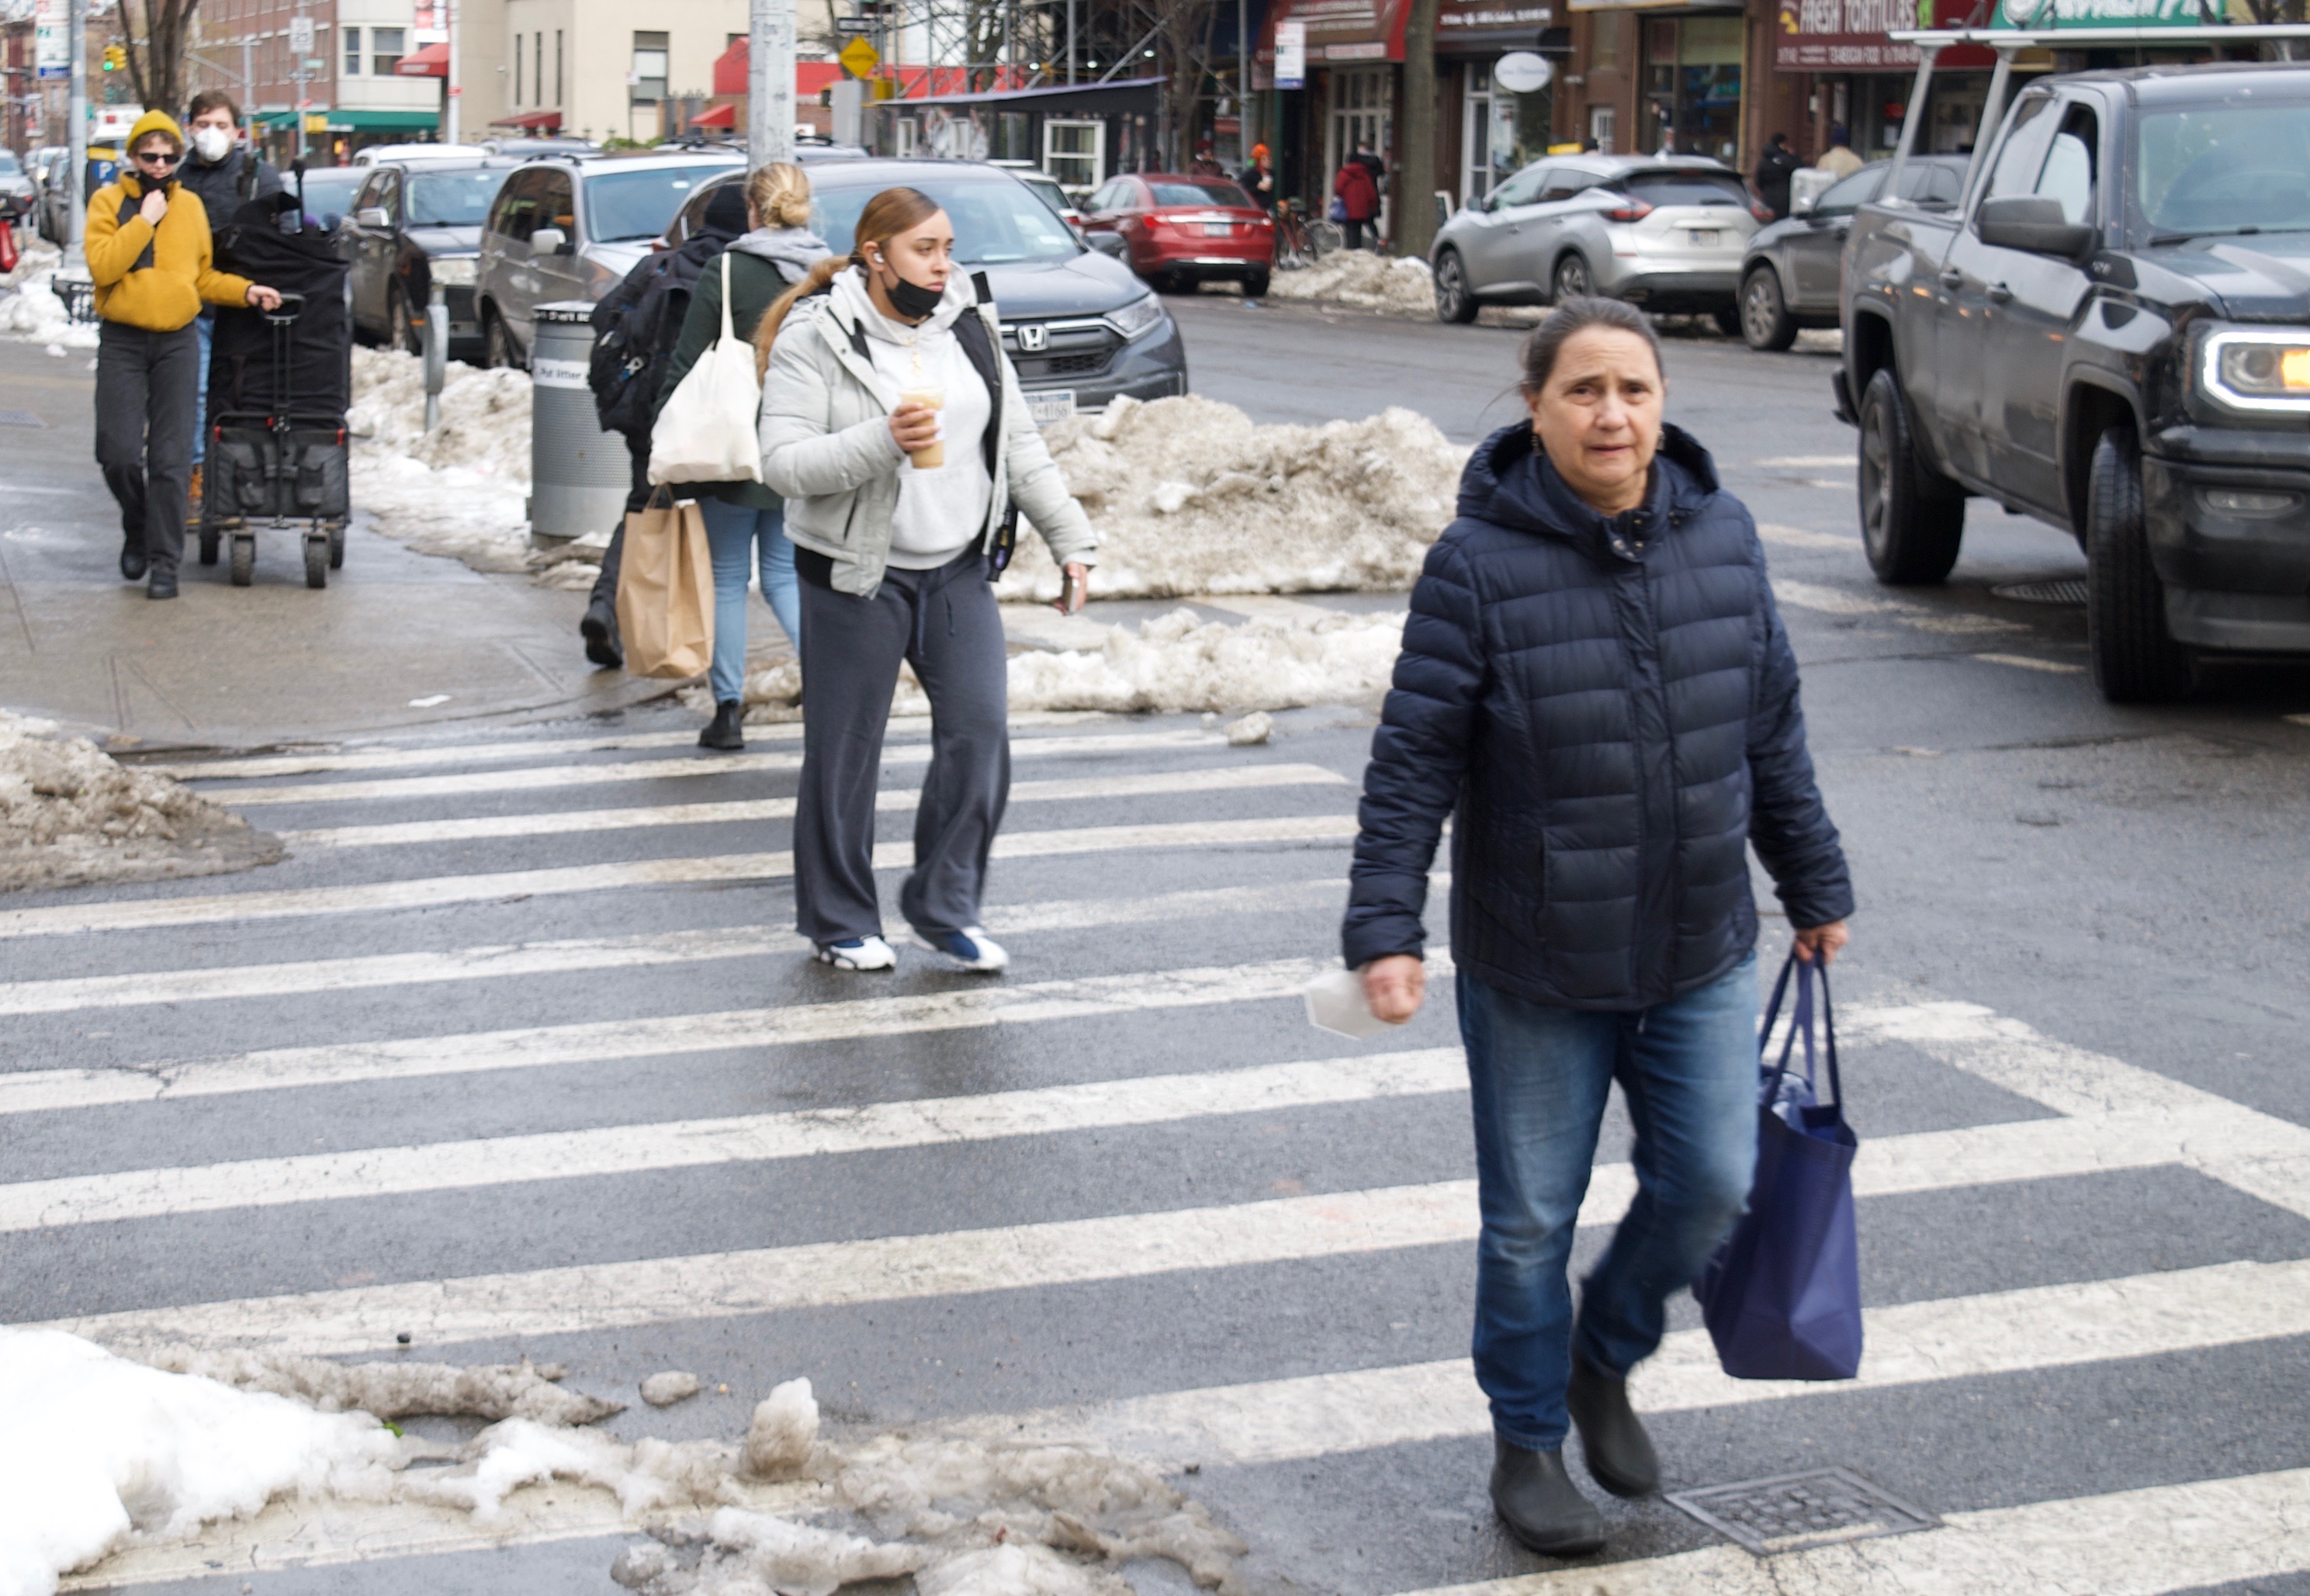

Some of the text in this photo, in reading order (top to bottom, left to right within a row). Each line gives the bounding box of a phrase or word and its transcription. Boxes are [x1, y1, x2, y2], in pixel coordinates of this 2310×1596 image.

[1799, 0, 1841, 34] FRESH
[1844, 0, 1917, 34] TORTILLAS
[99, 161, 113, 179] P
